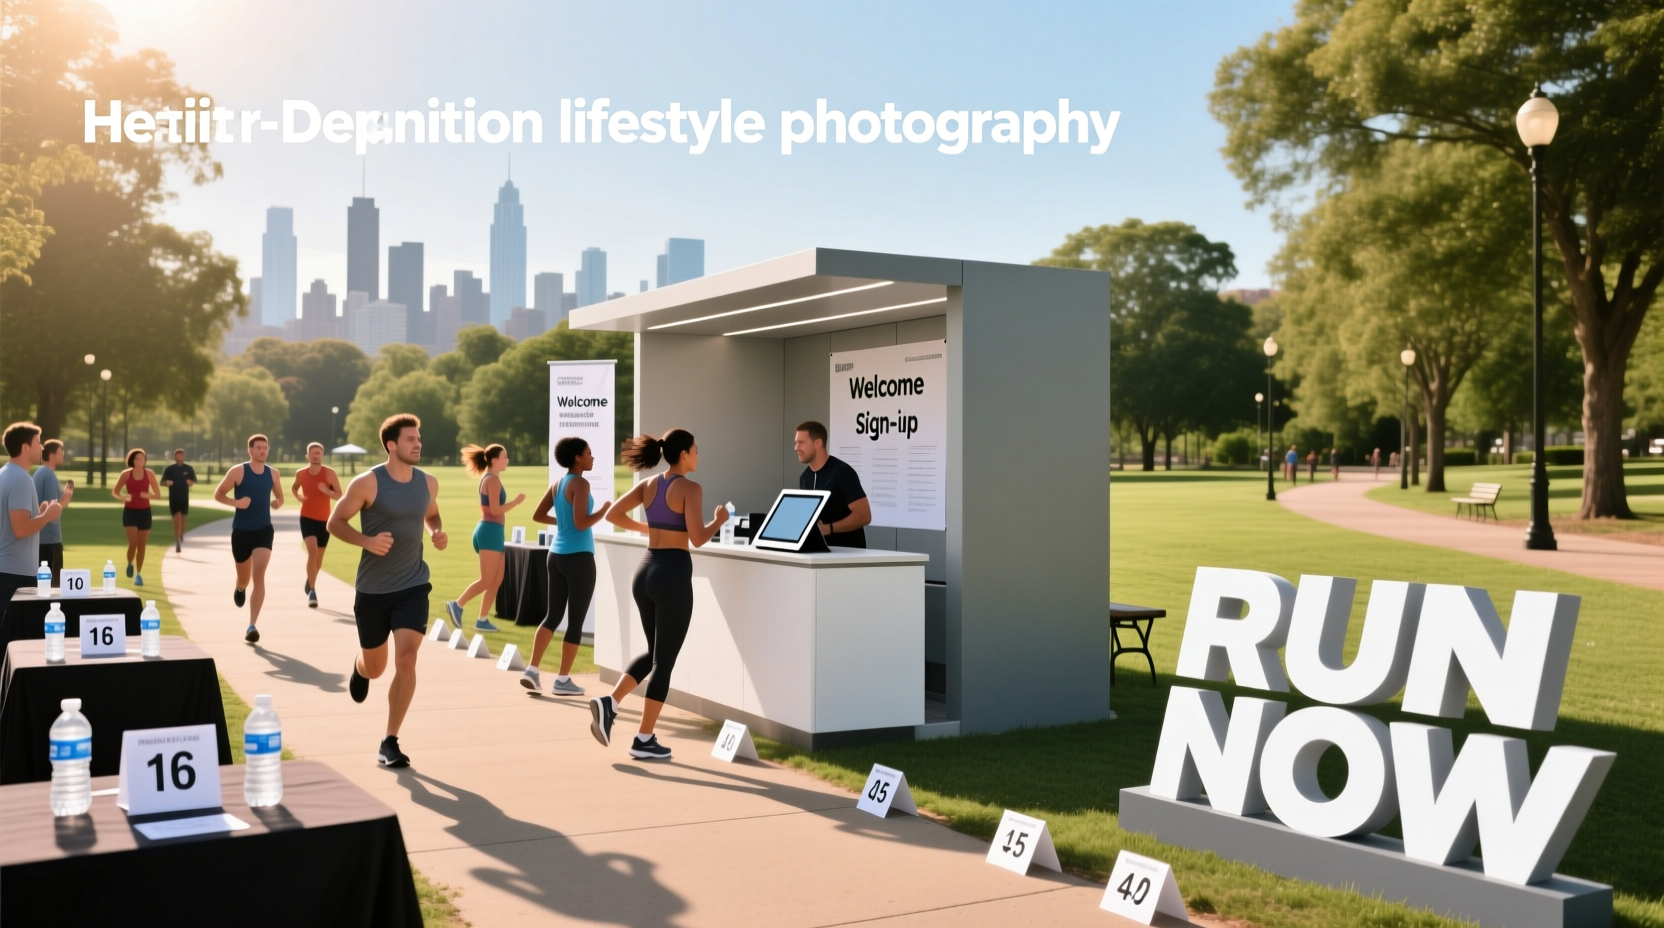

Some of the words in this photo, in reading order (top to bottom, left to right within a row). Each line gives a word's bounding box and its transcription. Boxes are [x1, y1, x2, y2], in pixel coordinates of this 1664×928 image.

[849, 374, 925, 399] Welcome
[67, 577, 84, 591] 10
[89, 626, 114, 646] 16
[1175, 566, 1581, 732] RUN
[147, 750, 196, 792] 16
[1149, 685, 1617, 885] NOW
[1117, 872, 1151, 905] 40
